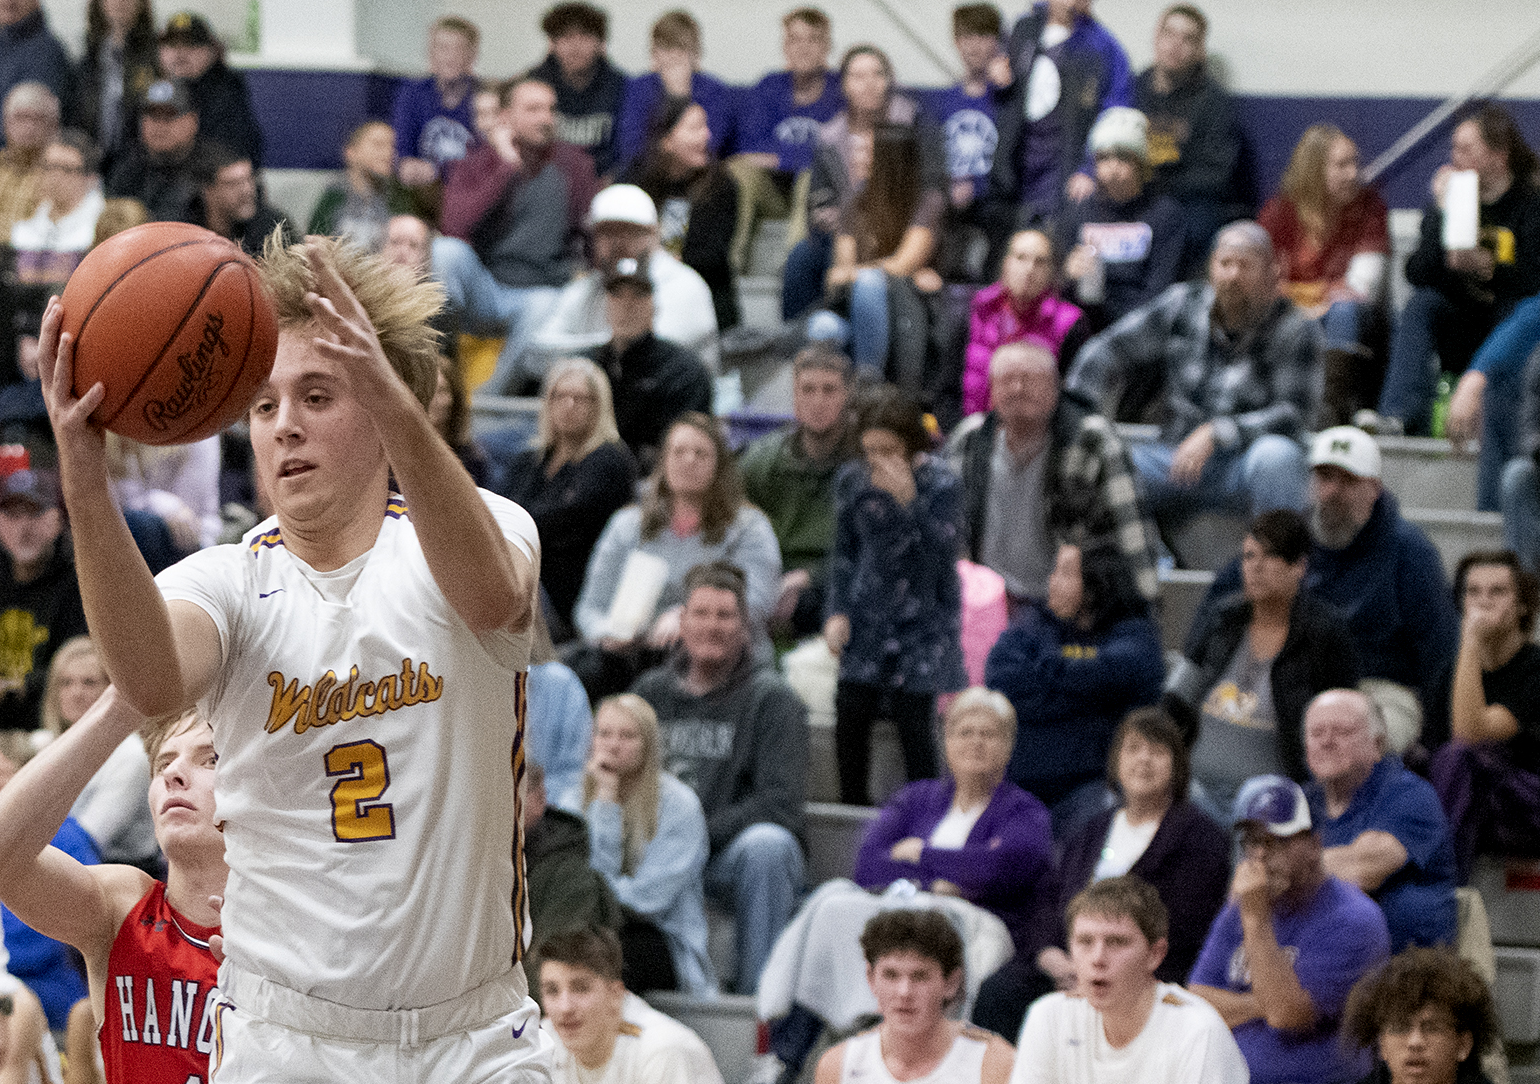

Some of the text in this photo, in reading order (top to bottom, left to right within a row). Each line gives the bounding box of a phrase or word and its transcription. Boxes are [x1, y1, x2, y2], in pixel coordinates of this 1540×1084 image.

[143, 310, 229, 431] Rawlings
[264, 657, 443, 735] Wildcats
[323, 738, 396, 843] 2
